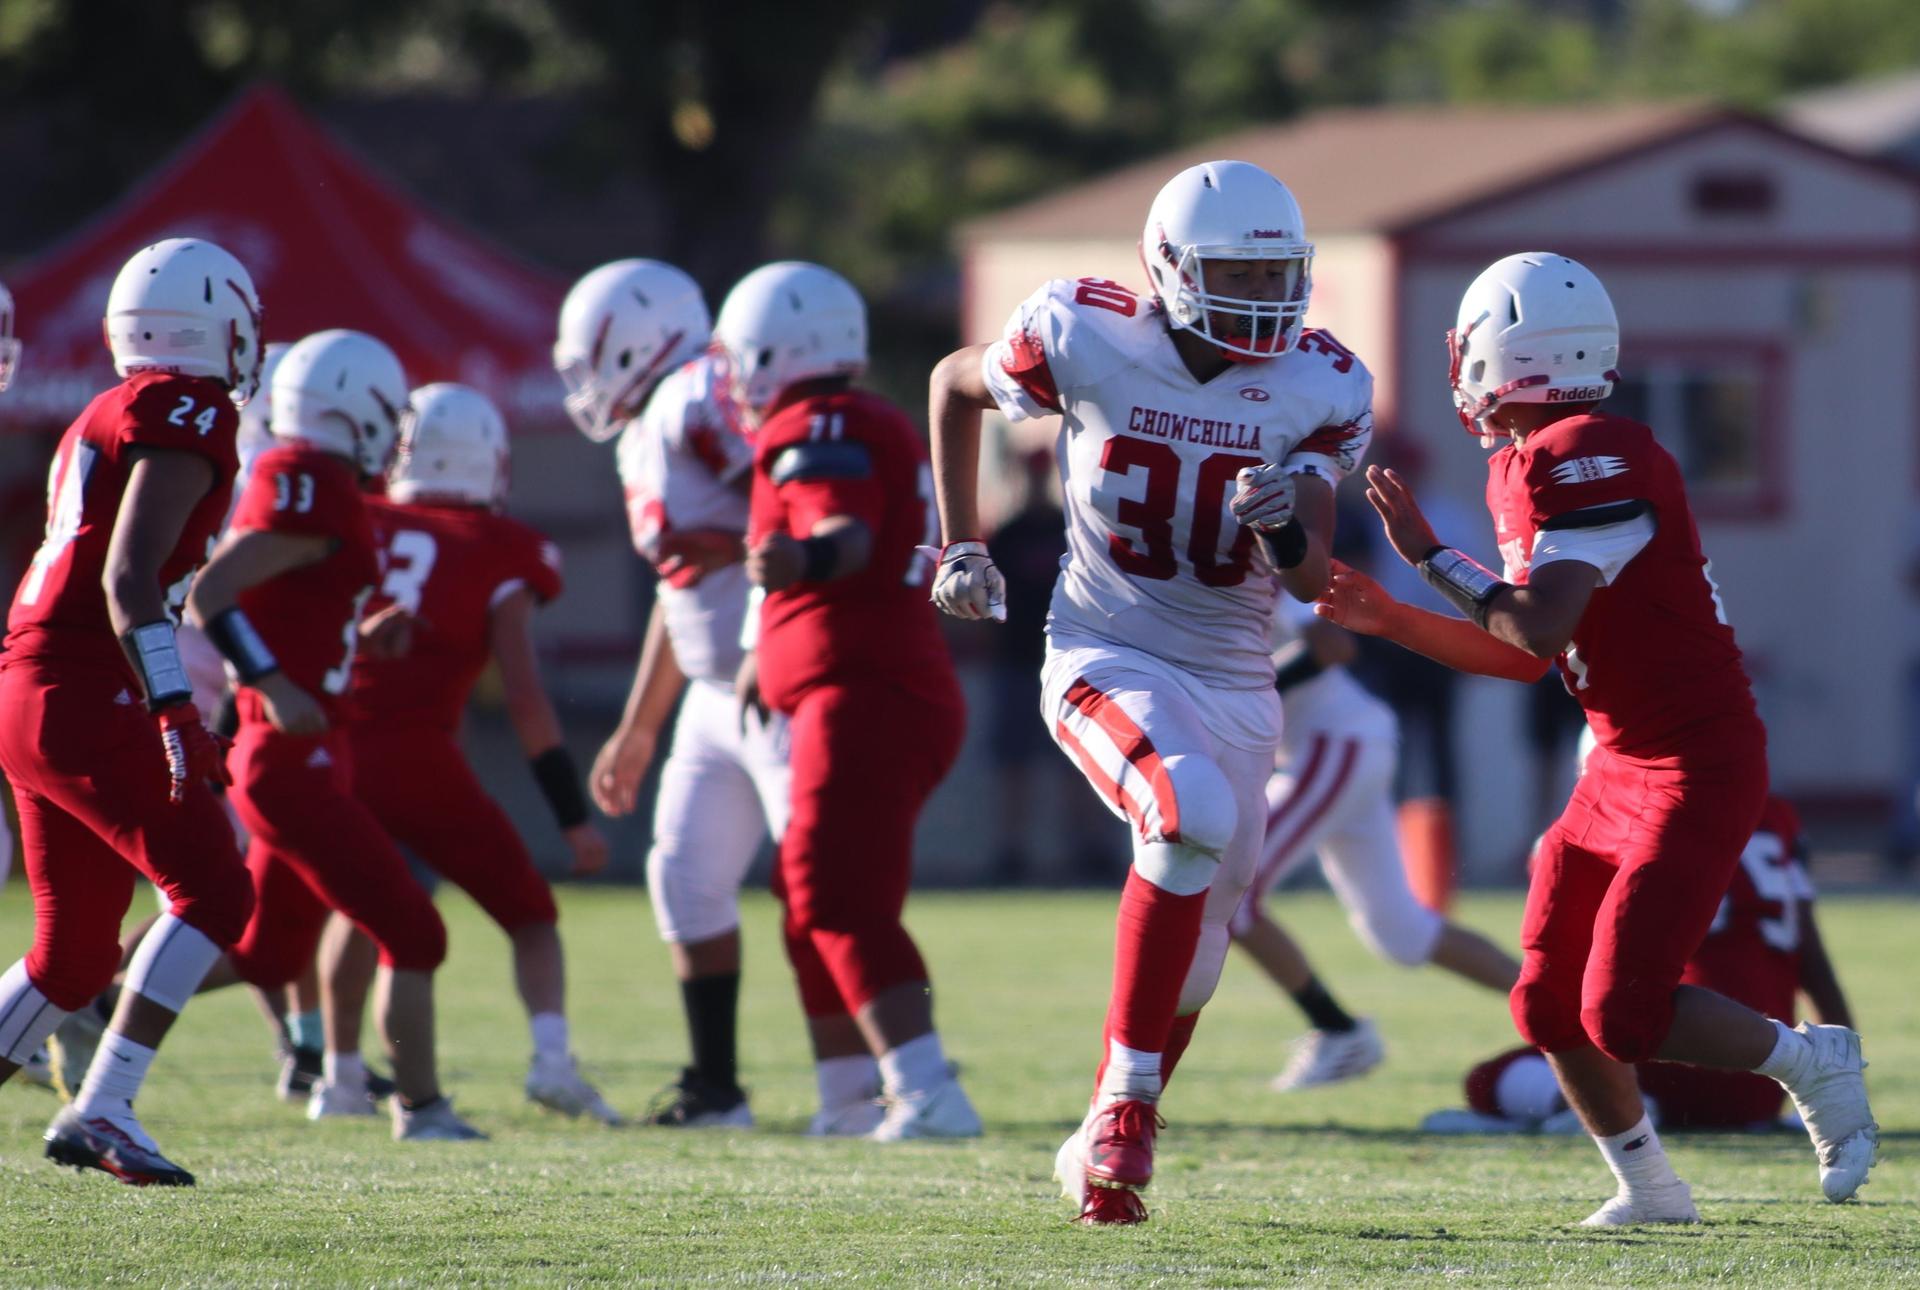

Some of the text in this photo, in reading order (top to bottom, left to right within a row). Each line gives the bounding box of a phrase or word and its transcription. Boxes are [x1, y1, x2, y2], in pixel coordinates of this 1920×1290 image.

[1296, 328, 1355, 374] 3
[167, 396, 218, 435] 24
[1546, 386, 1605, 401] Riddell
[1128, 406, 1262, 450] CHOWCHILLA
[1100, 434, 1266, 588] 30
